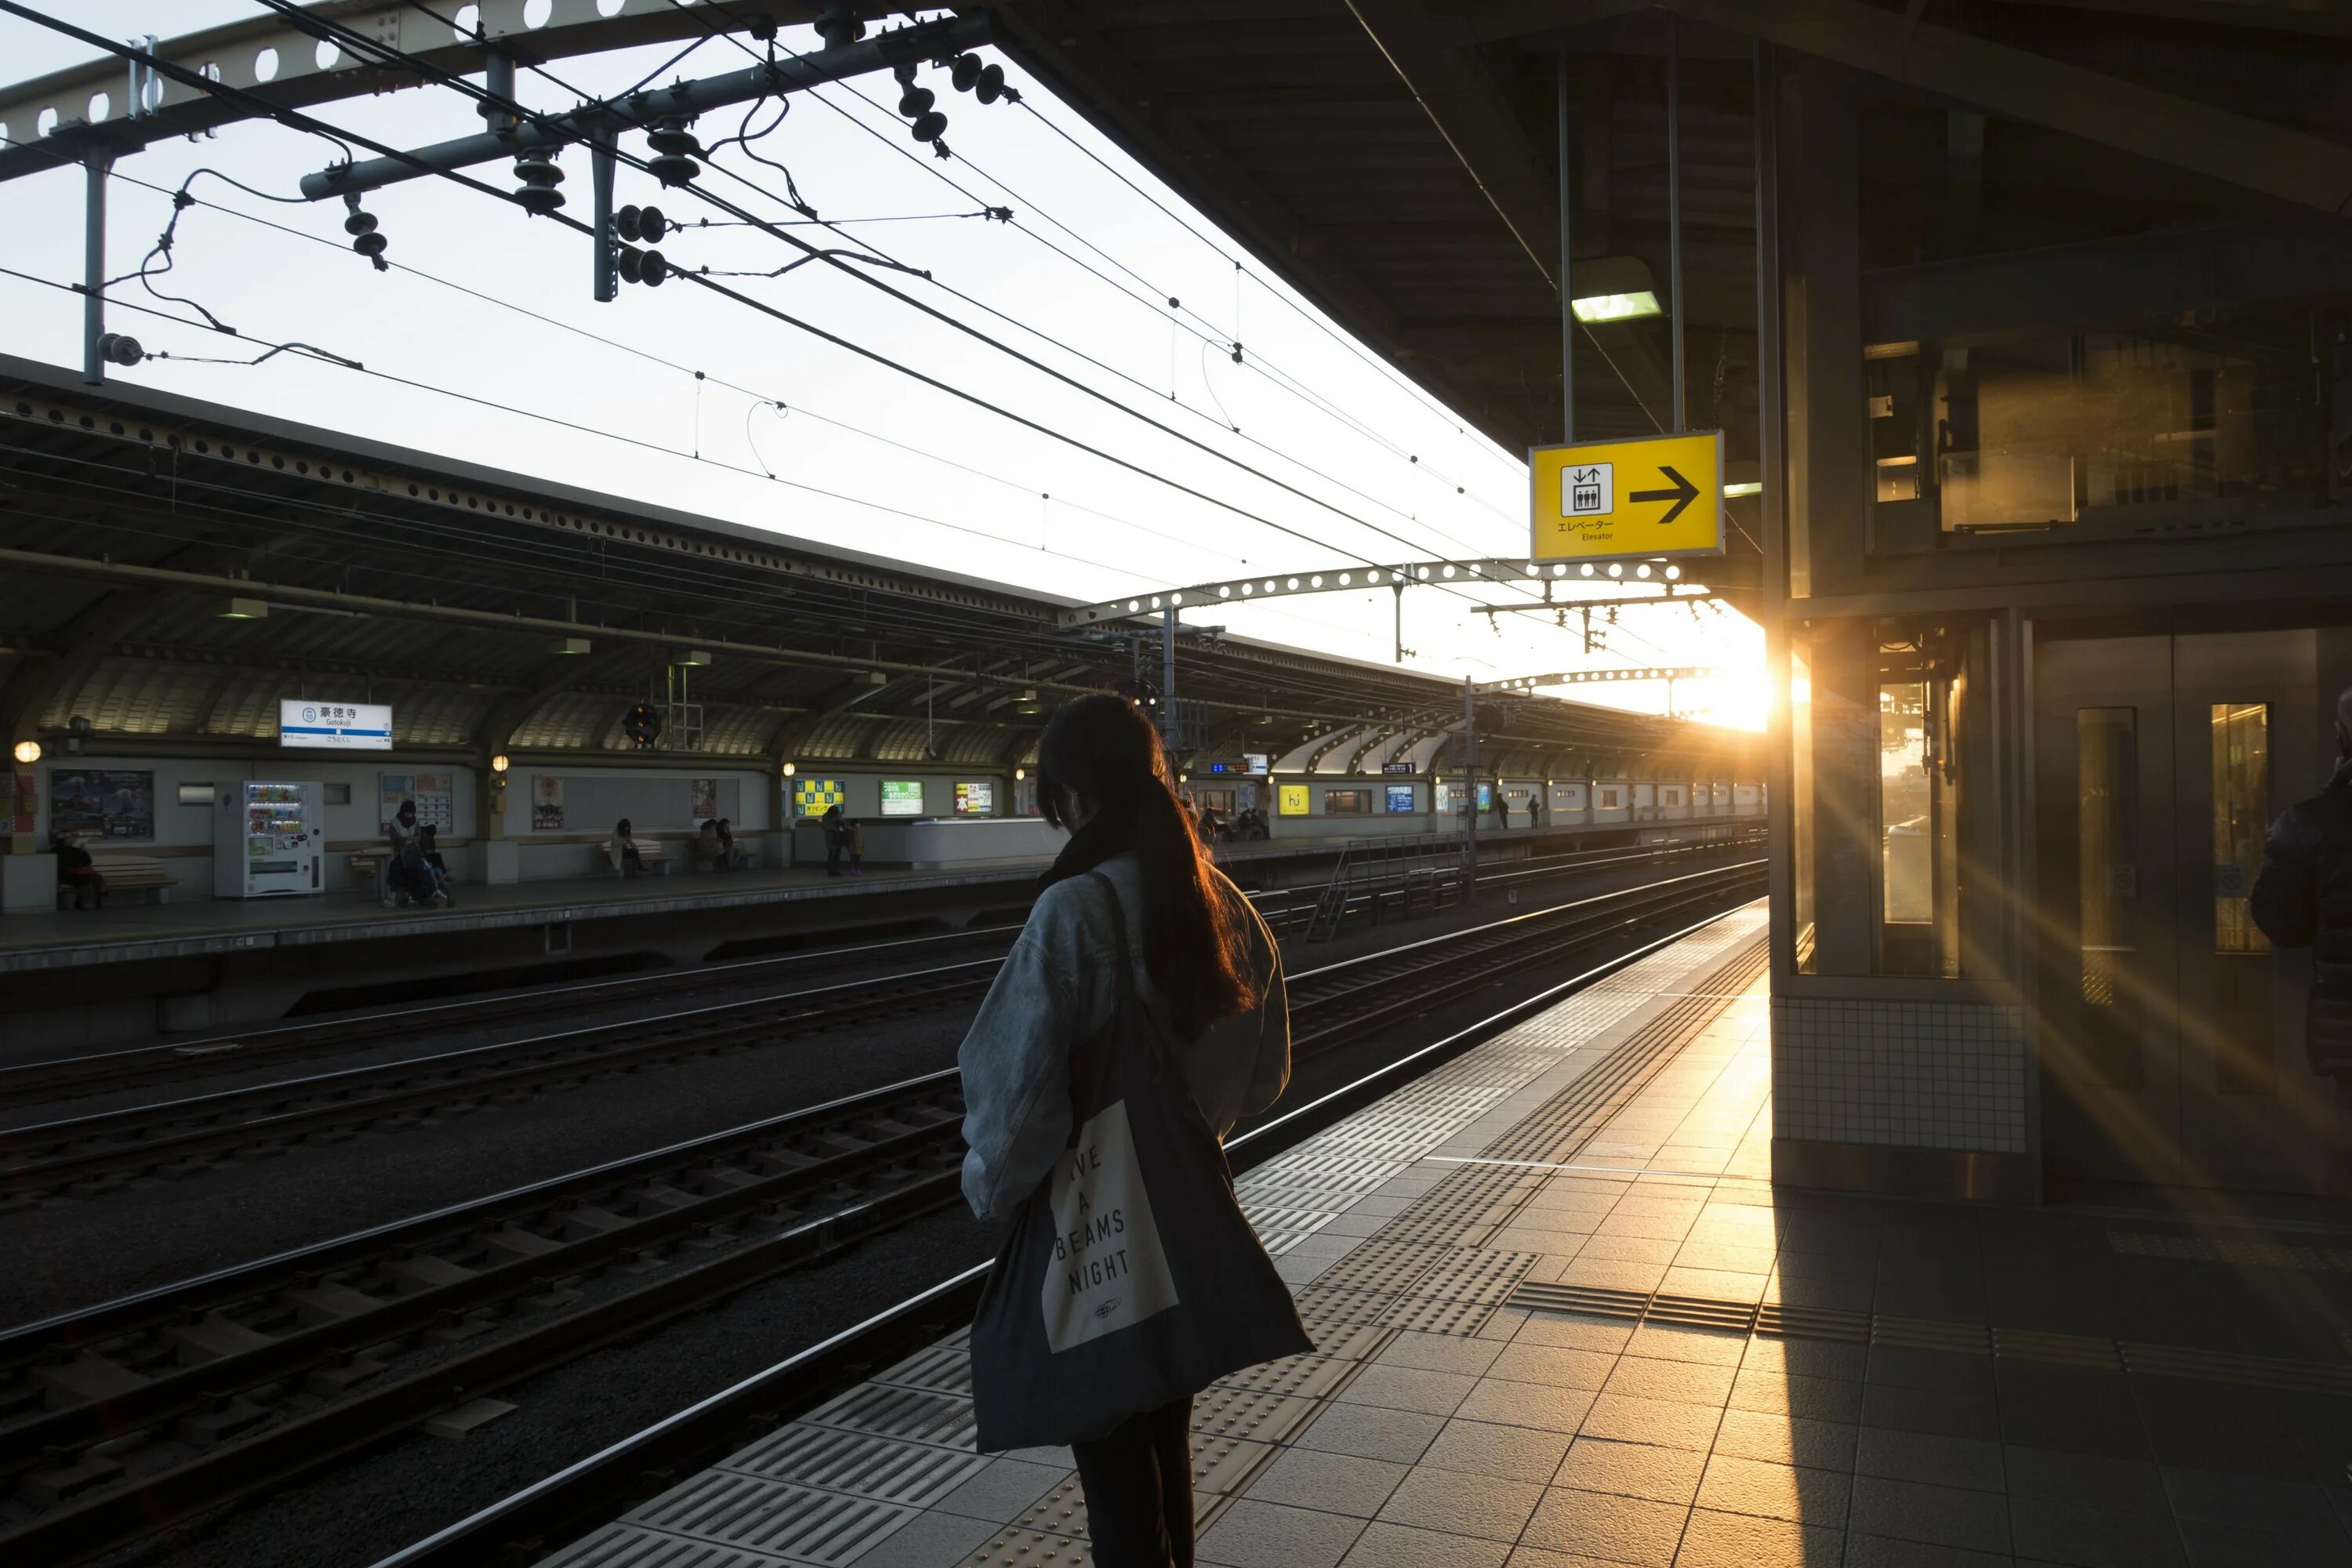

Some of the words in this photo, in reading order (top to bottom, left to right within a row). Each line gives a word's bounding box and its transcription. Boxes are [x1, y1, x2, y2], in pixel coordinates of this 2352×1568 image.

[1558, 521, 1613, 532] エレベーター
[320, 707, 357, 719] 豪徳寺
[326, 719, 351, 728] Gotokuji
[1079, 1191, 1090, 1214] A
[1056, 1209, 1124, 1261] BEAMS
[1069, 1250, 1128, 1294] NIGHT
